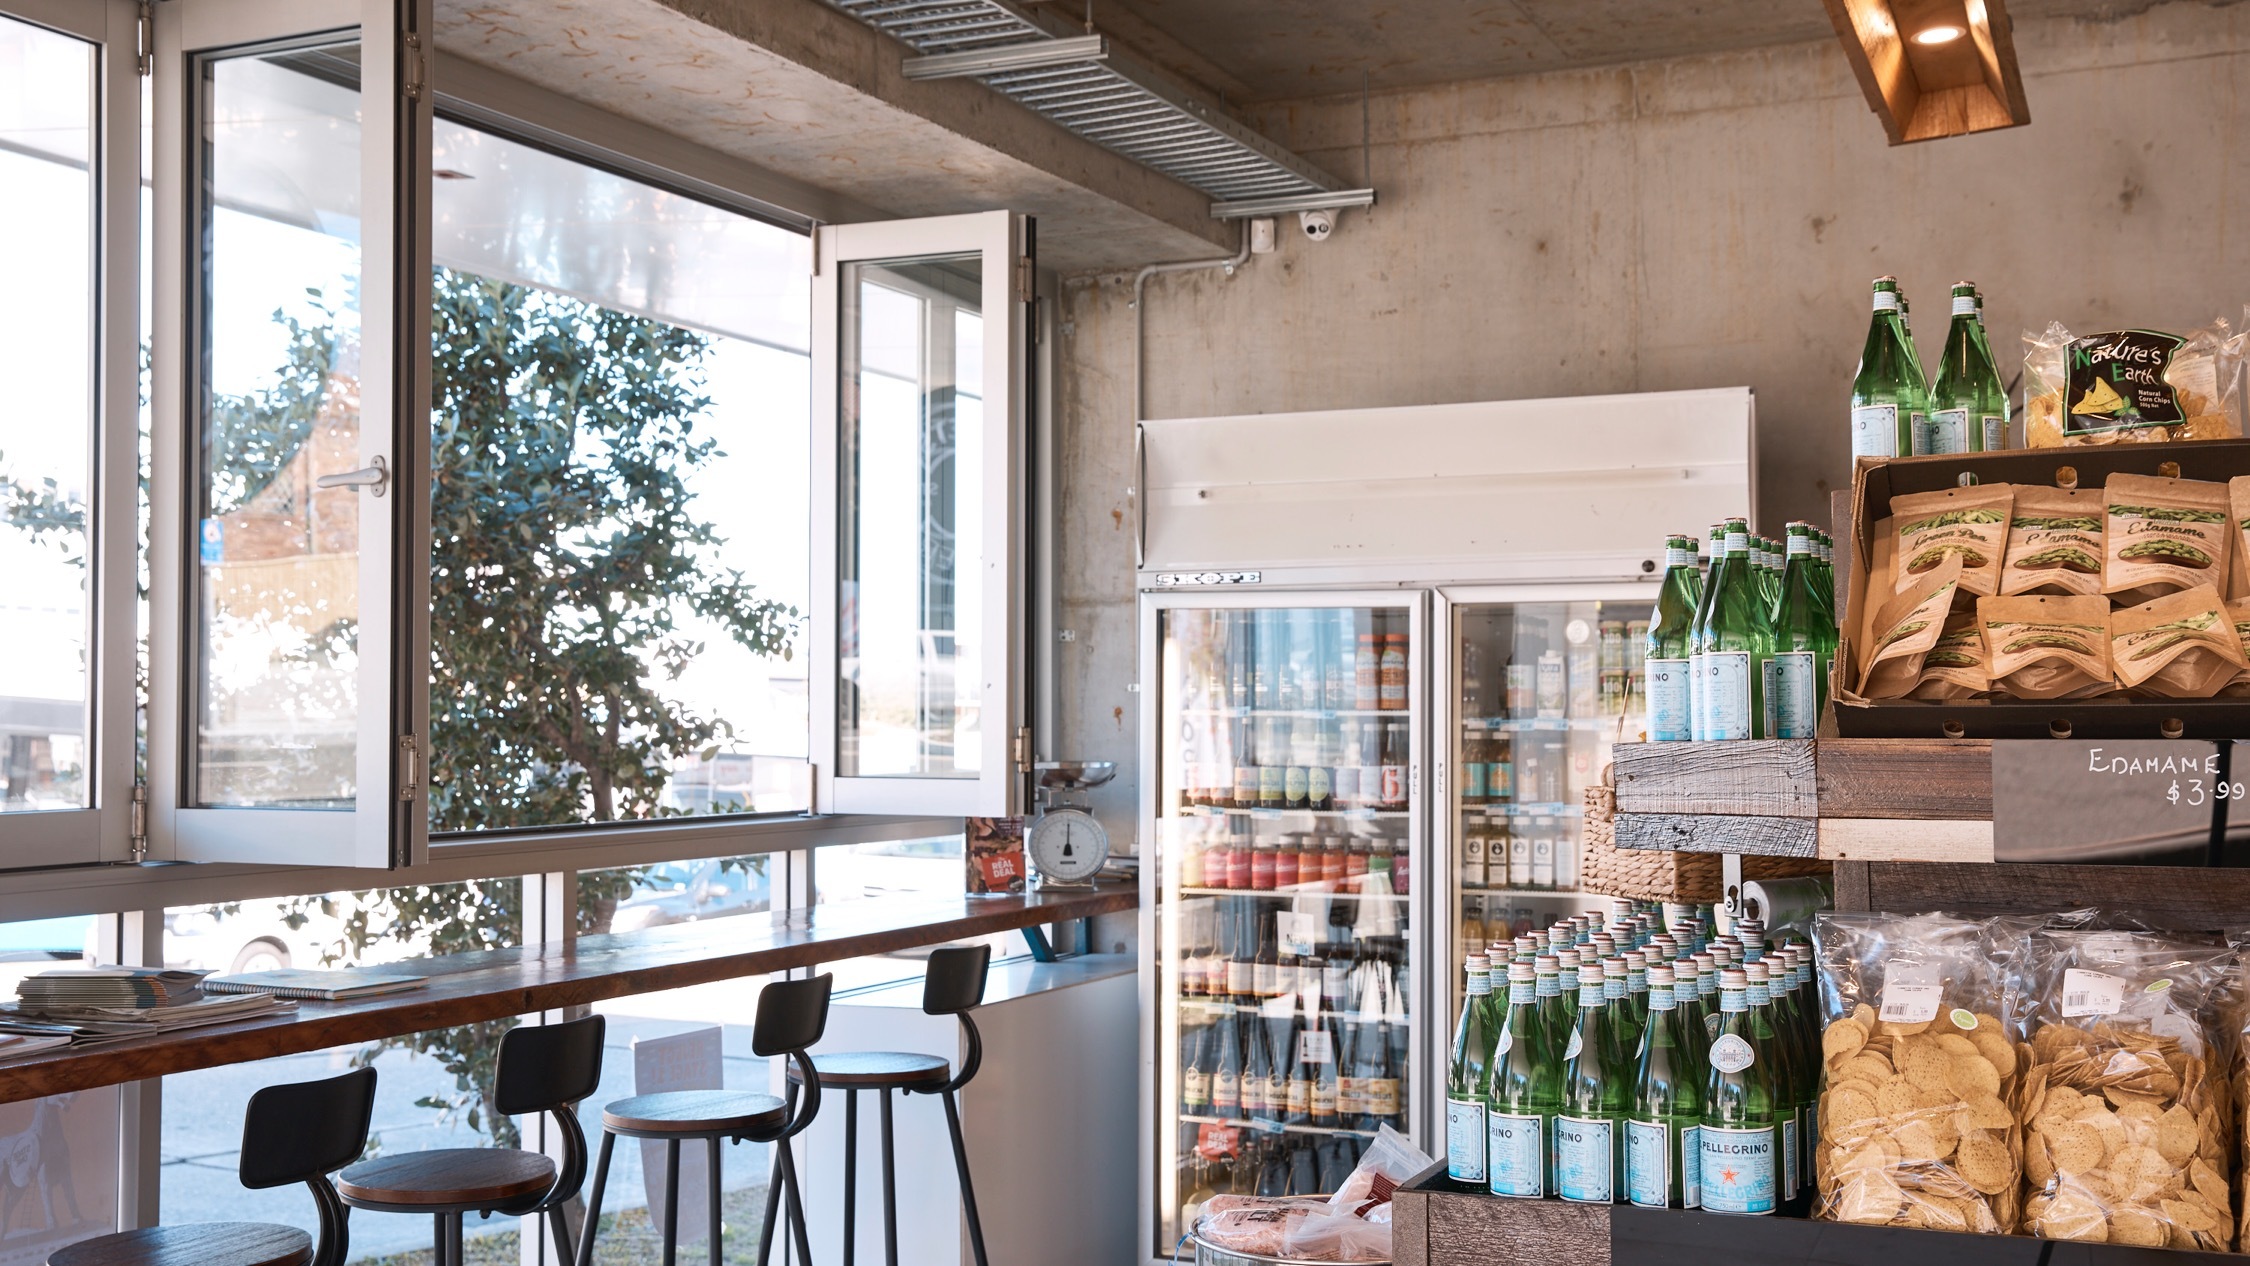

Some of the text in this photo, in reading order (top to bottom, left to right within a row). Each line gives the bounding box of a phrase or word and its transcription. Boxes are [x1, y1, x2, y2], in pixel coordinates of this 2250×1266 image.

[2075, 337, 2162, 370] Nature's
[2111, 362, 2159, 386] Earth
[2138, 389, 2161, 397] Natural
[2138, 395, 2171, 405] Corn Chips
[1912, 527, 1988, 551] Green Pea
[1156, 571, 1261, 586] SKOPE
[2089, 748, 2221, 775] EDAMAME
[2166, 779, 2245, 805] $3.99
[991, 859, 1014, 871] REAL
[993, 867, 1016, 878] DEAL
[1700, 1140, 1769, 1155] .PELLEGRINO
